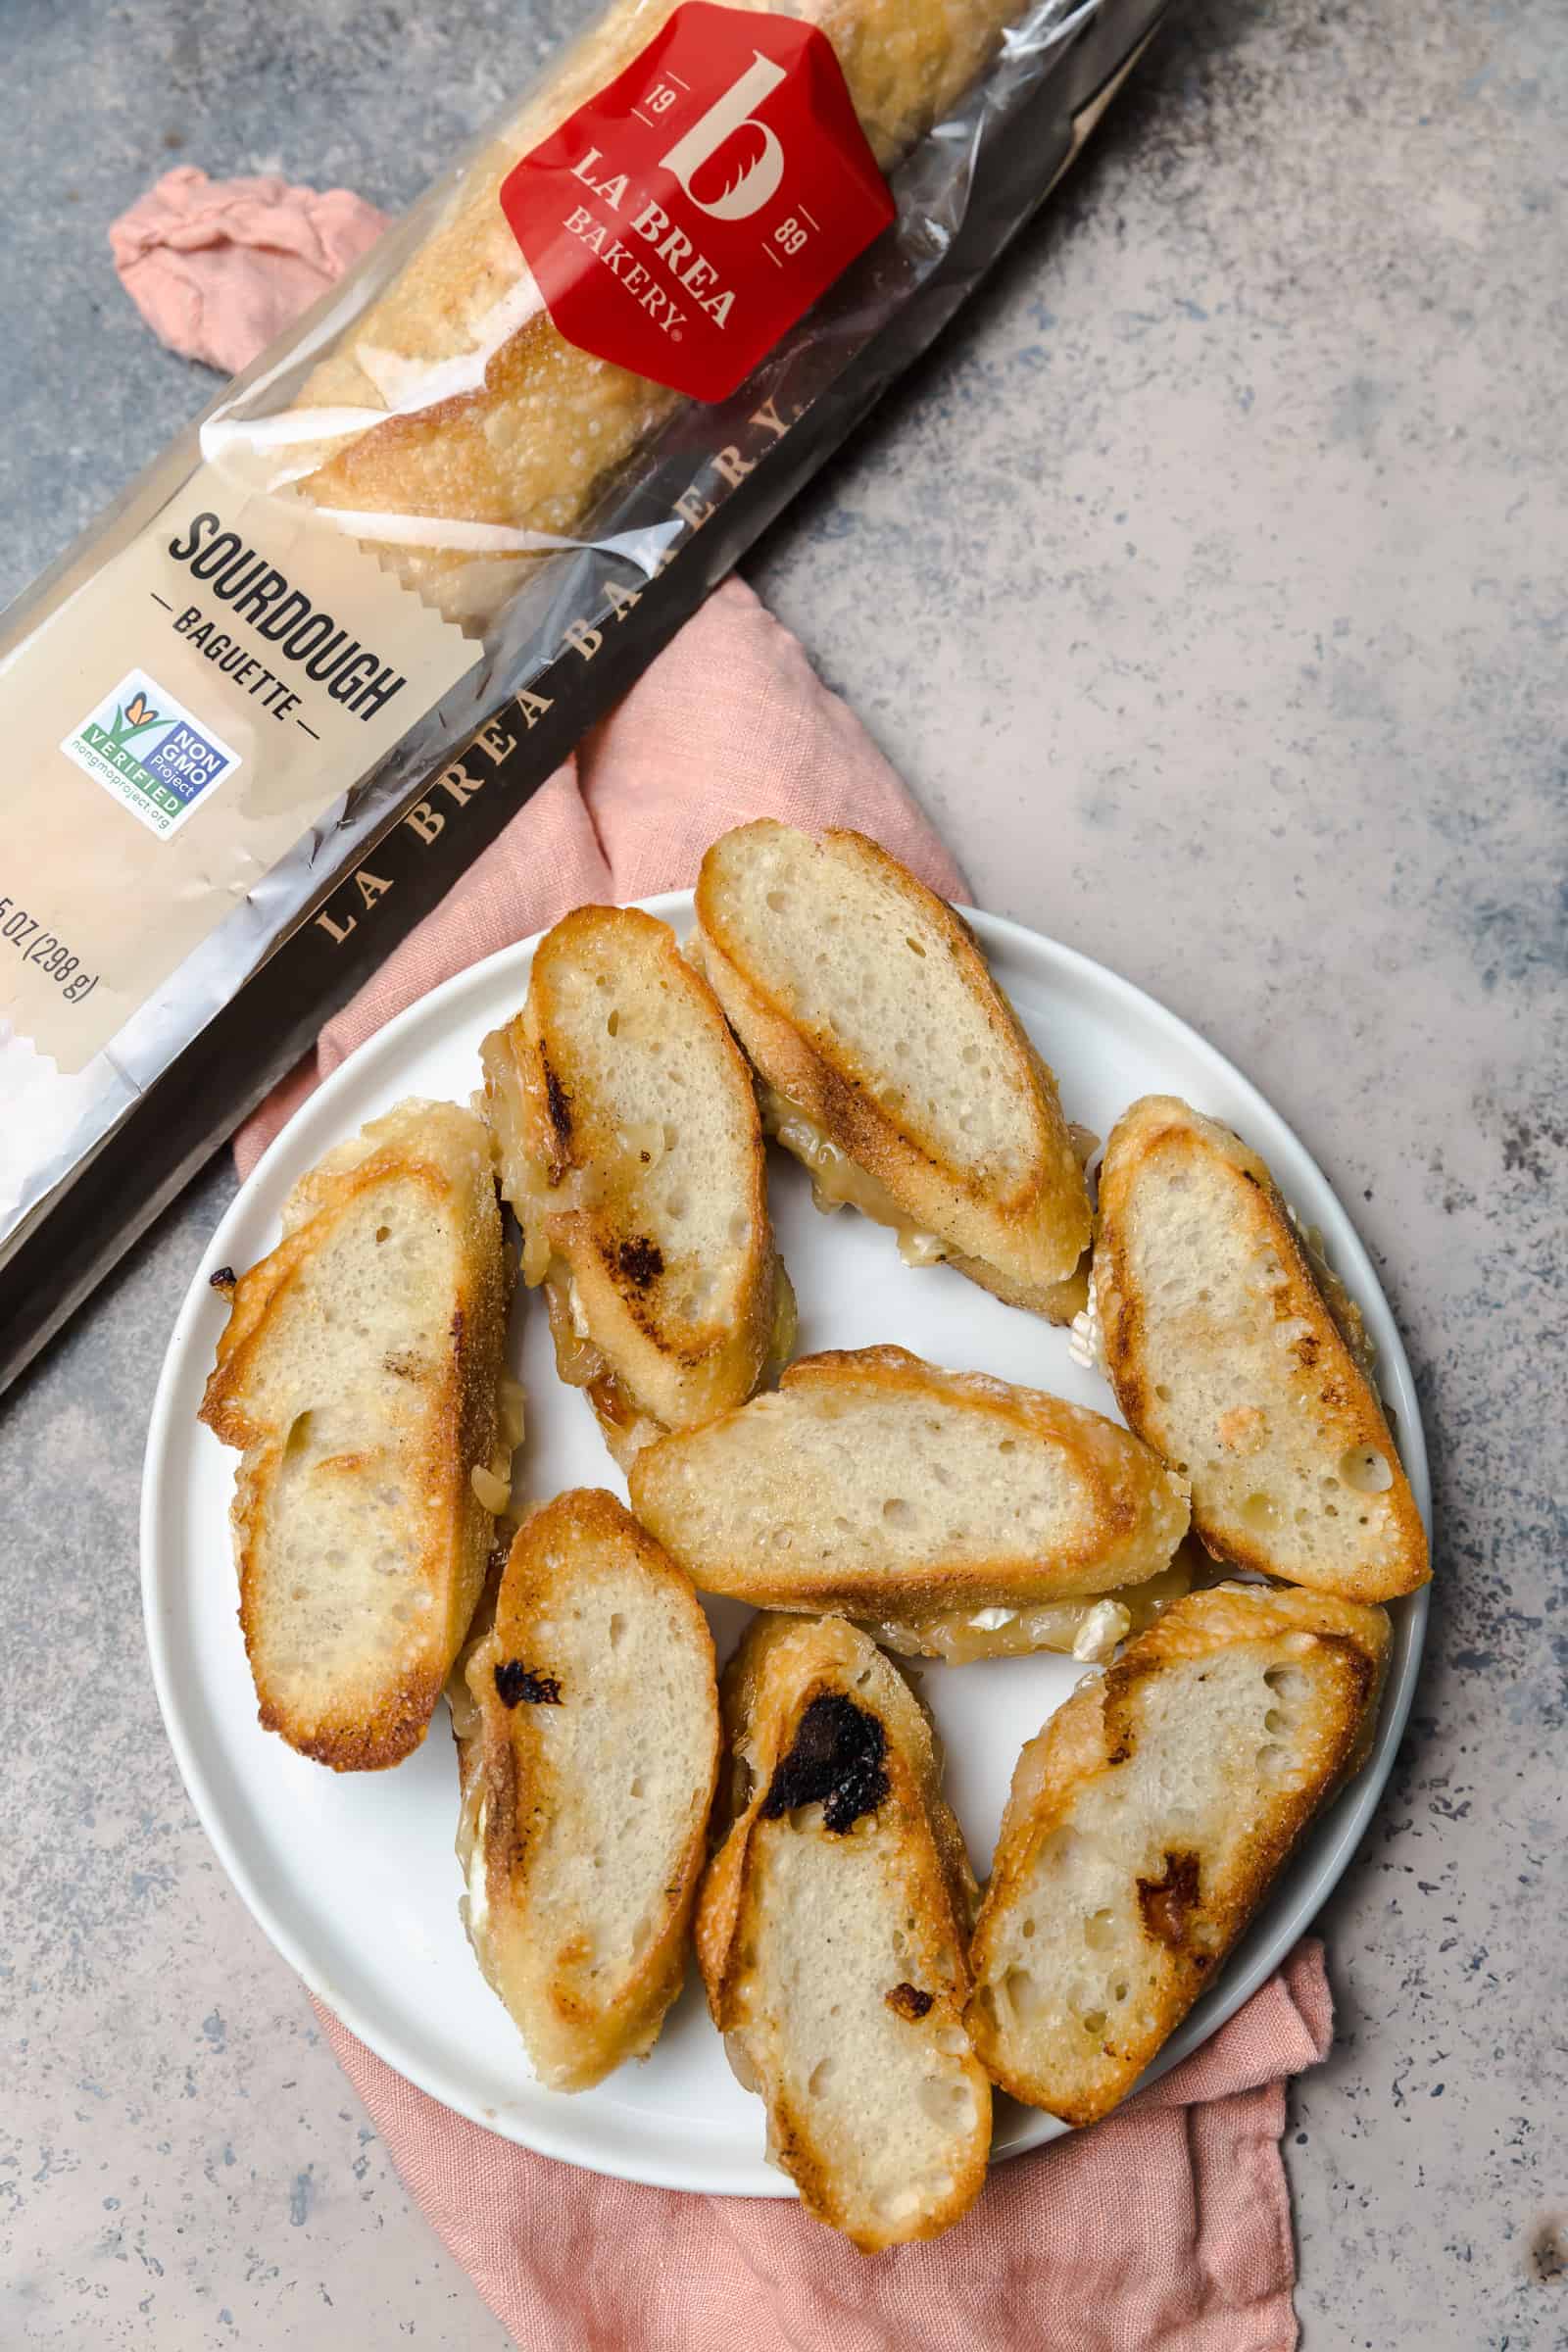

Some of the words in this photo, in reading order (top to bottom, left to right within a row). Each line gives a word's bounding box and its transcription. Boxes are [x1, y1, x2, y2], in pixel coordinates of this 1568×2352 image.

[643, 83, 677, 115] 19
[658, 49, 788, 220] b
[570, 147, 631, 212] LA
[629, 200, 737, 330] BREA
[773, 217, 808, 257] 89
[168, 512, 408, 722] SOURDOUGH
[172, 606, 303, 721] BAGUETTE
[72, 739, 171, 830] nongmoproject.org
[89, 729, 179, 812] VERIFIED
[150, 755, 196, 797] Project
[162, 744, 208, 785] GMO
[173, 729, 221, 773] NON
[315, 869, 394, 945] LA
[404, 689, 555, 846] BREA
[1, 910, 40, 948] OZ
[22, 932, 80, 983] (298
[62, 974, 100, 1004] g)
